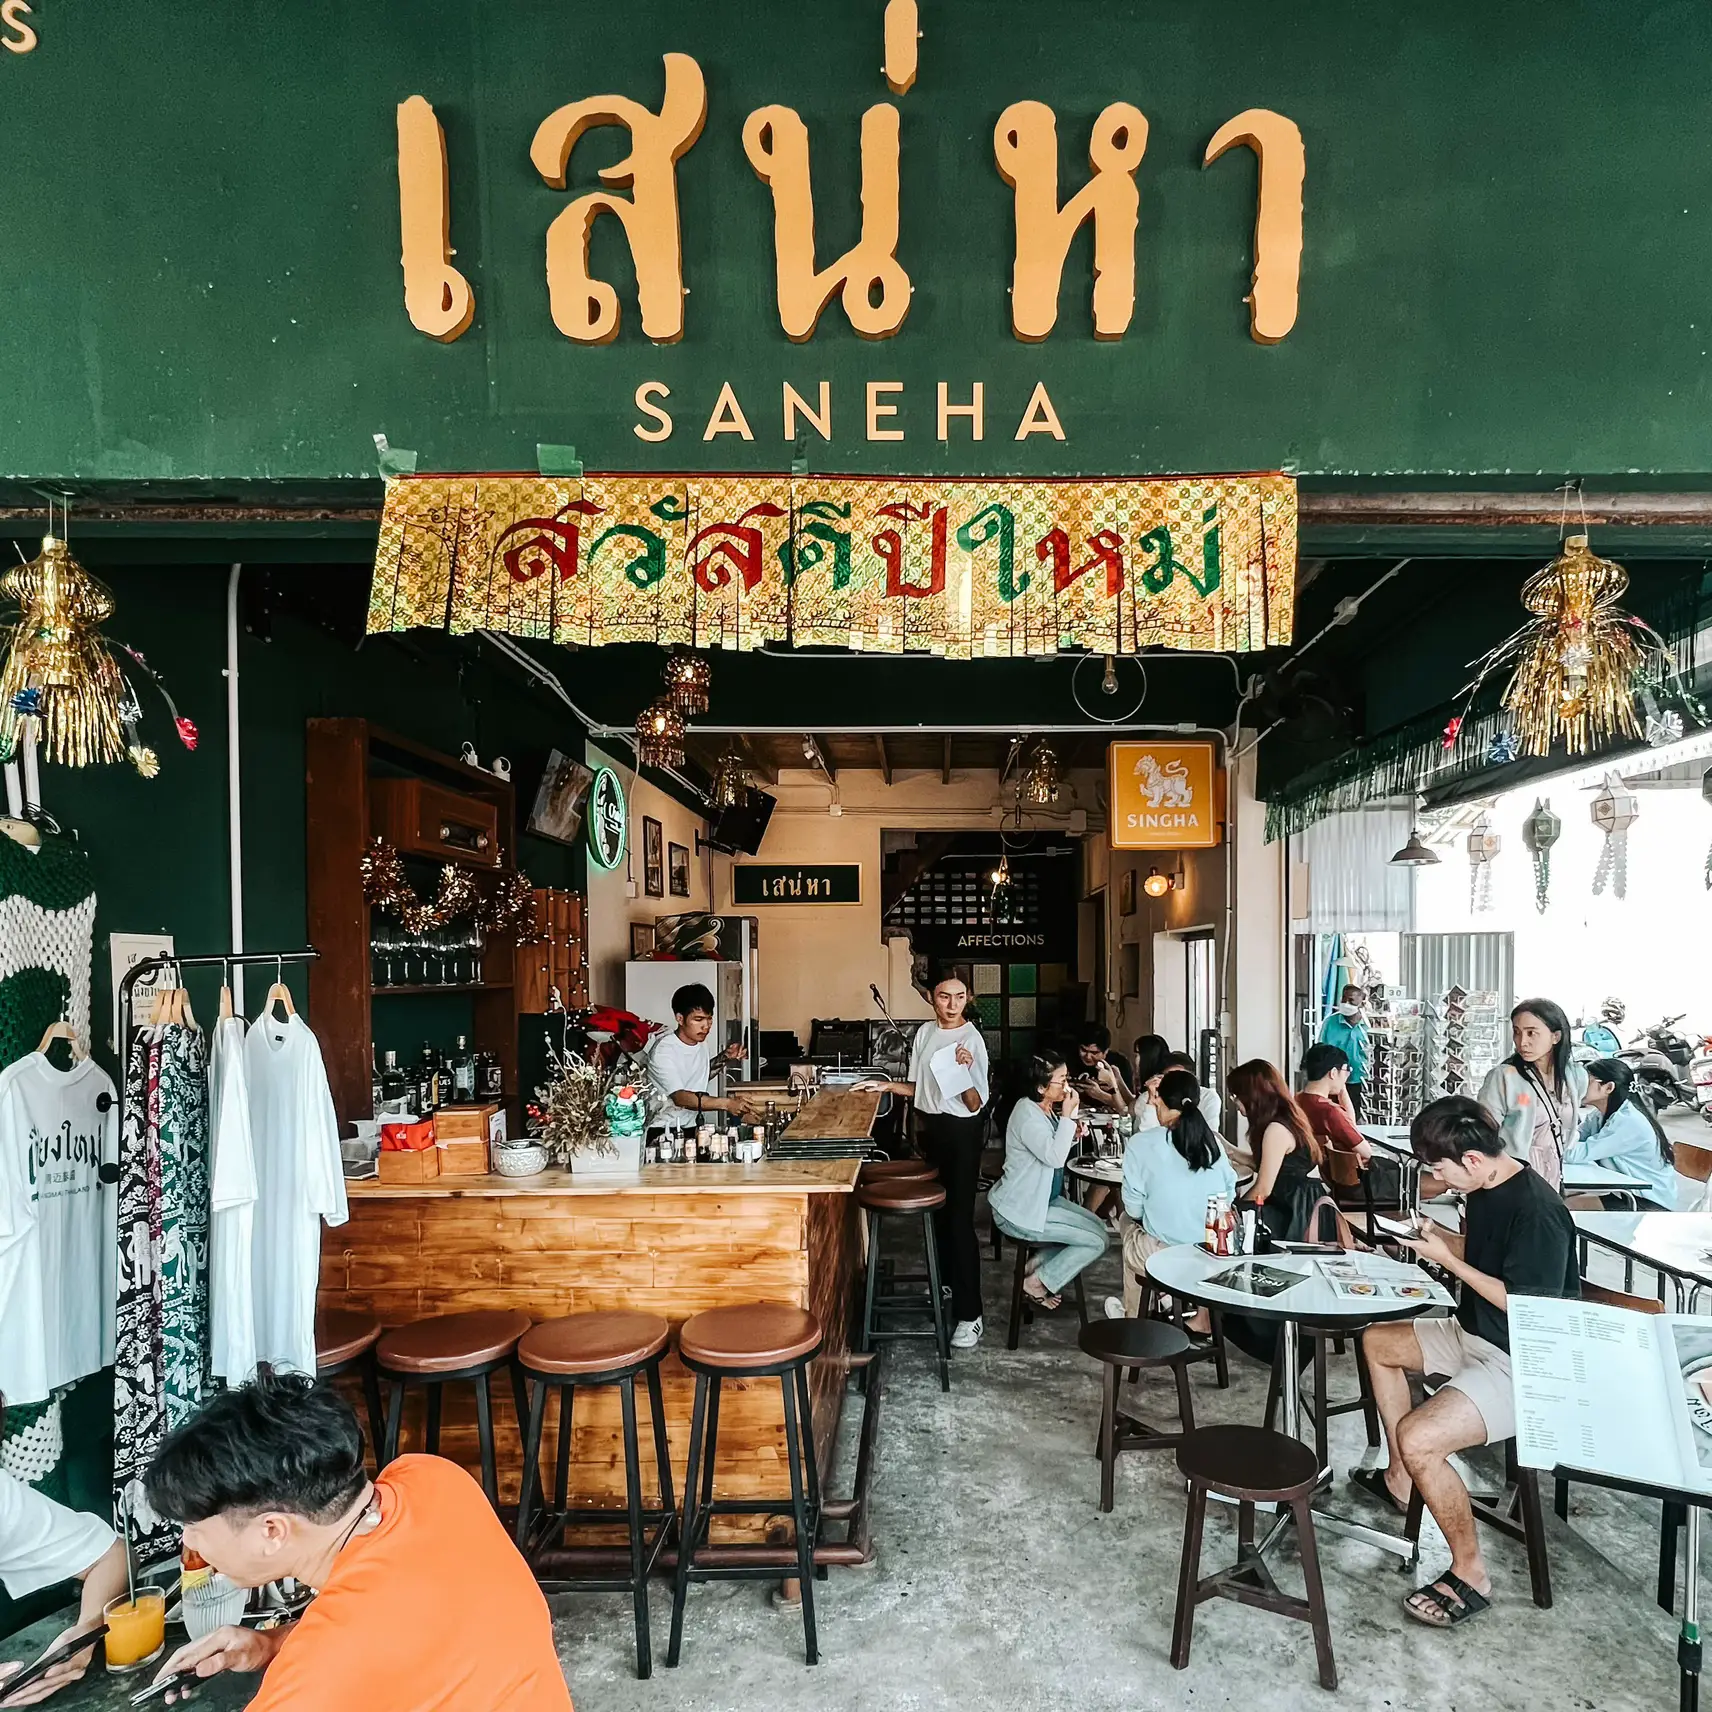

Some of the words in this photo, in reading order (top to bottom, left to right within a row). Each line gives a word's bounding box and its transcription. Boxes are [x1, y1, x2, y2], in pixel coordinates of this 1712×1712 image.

[397, 0, 1306, 345] เสน่หา
[633, 381, 1066, 442] SANEHA
[490, 494, 1221, 602] สวัสดีปีใหม่
[1127, 813, 1199, 828] SINGHA
[762, 871, 831, 897] เสน่หา
[957, 934, 1045, 947] AFFECTIONS
[1388, 989, 1402, 997] 30
